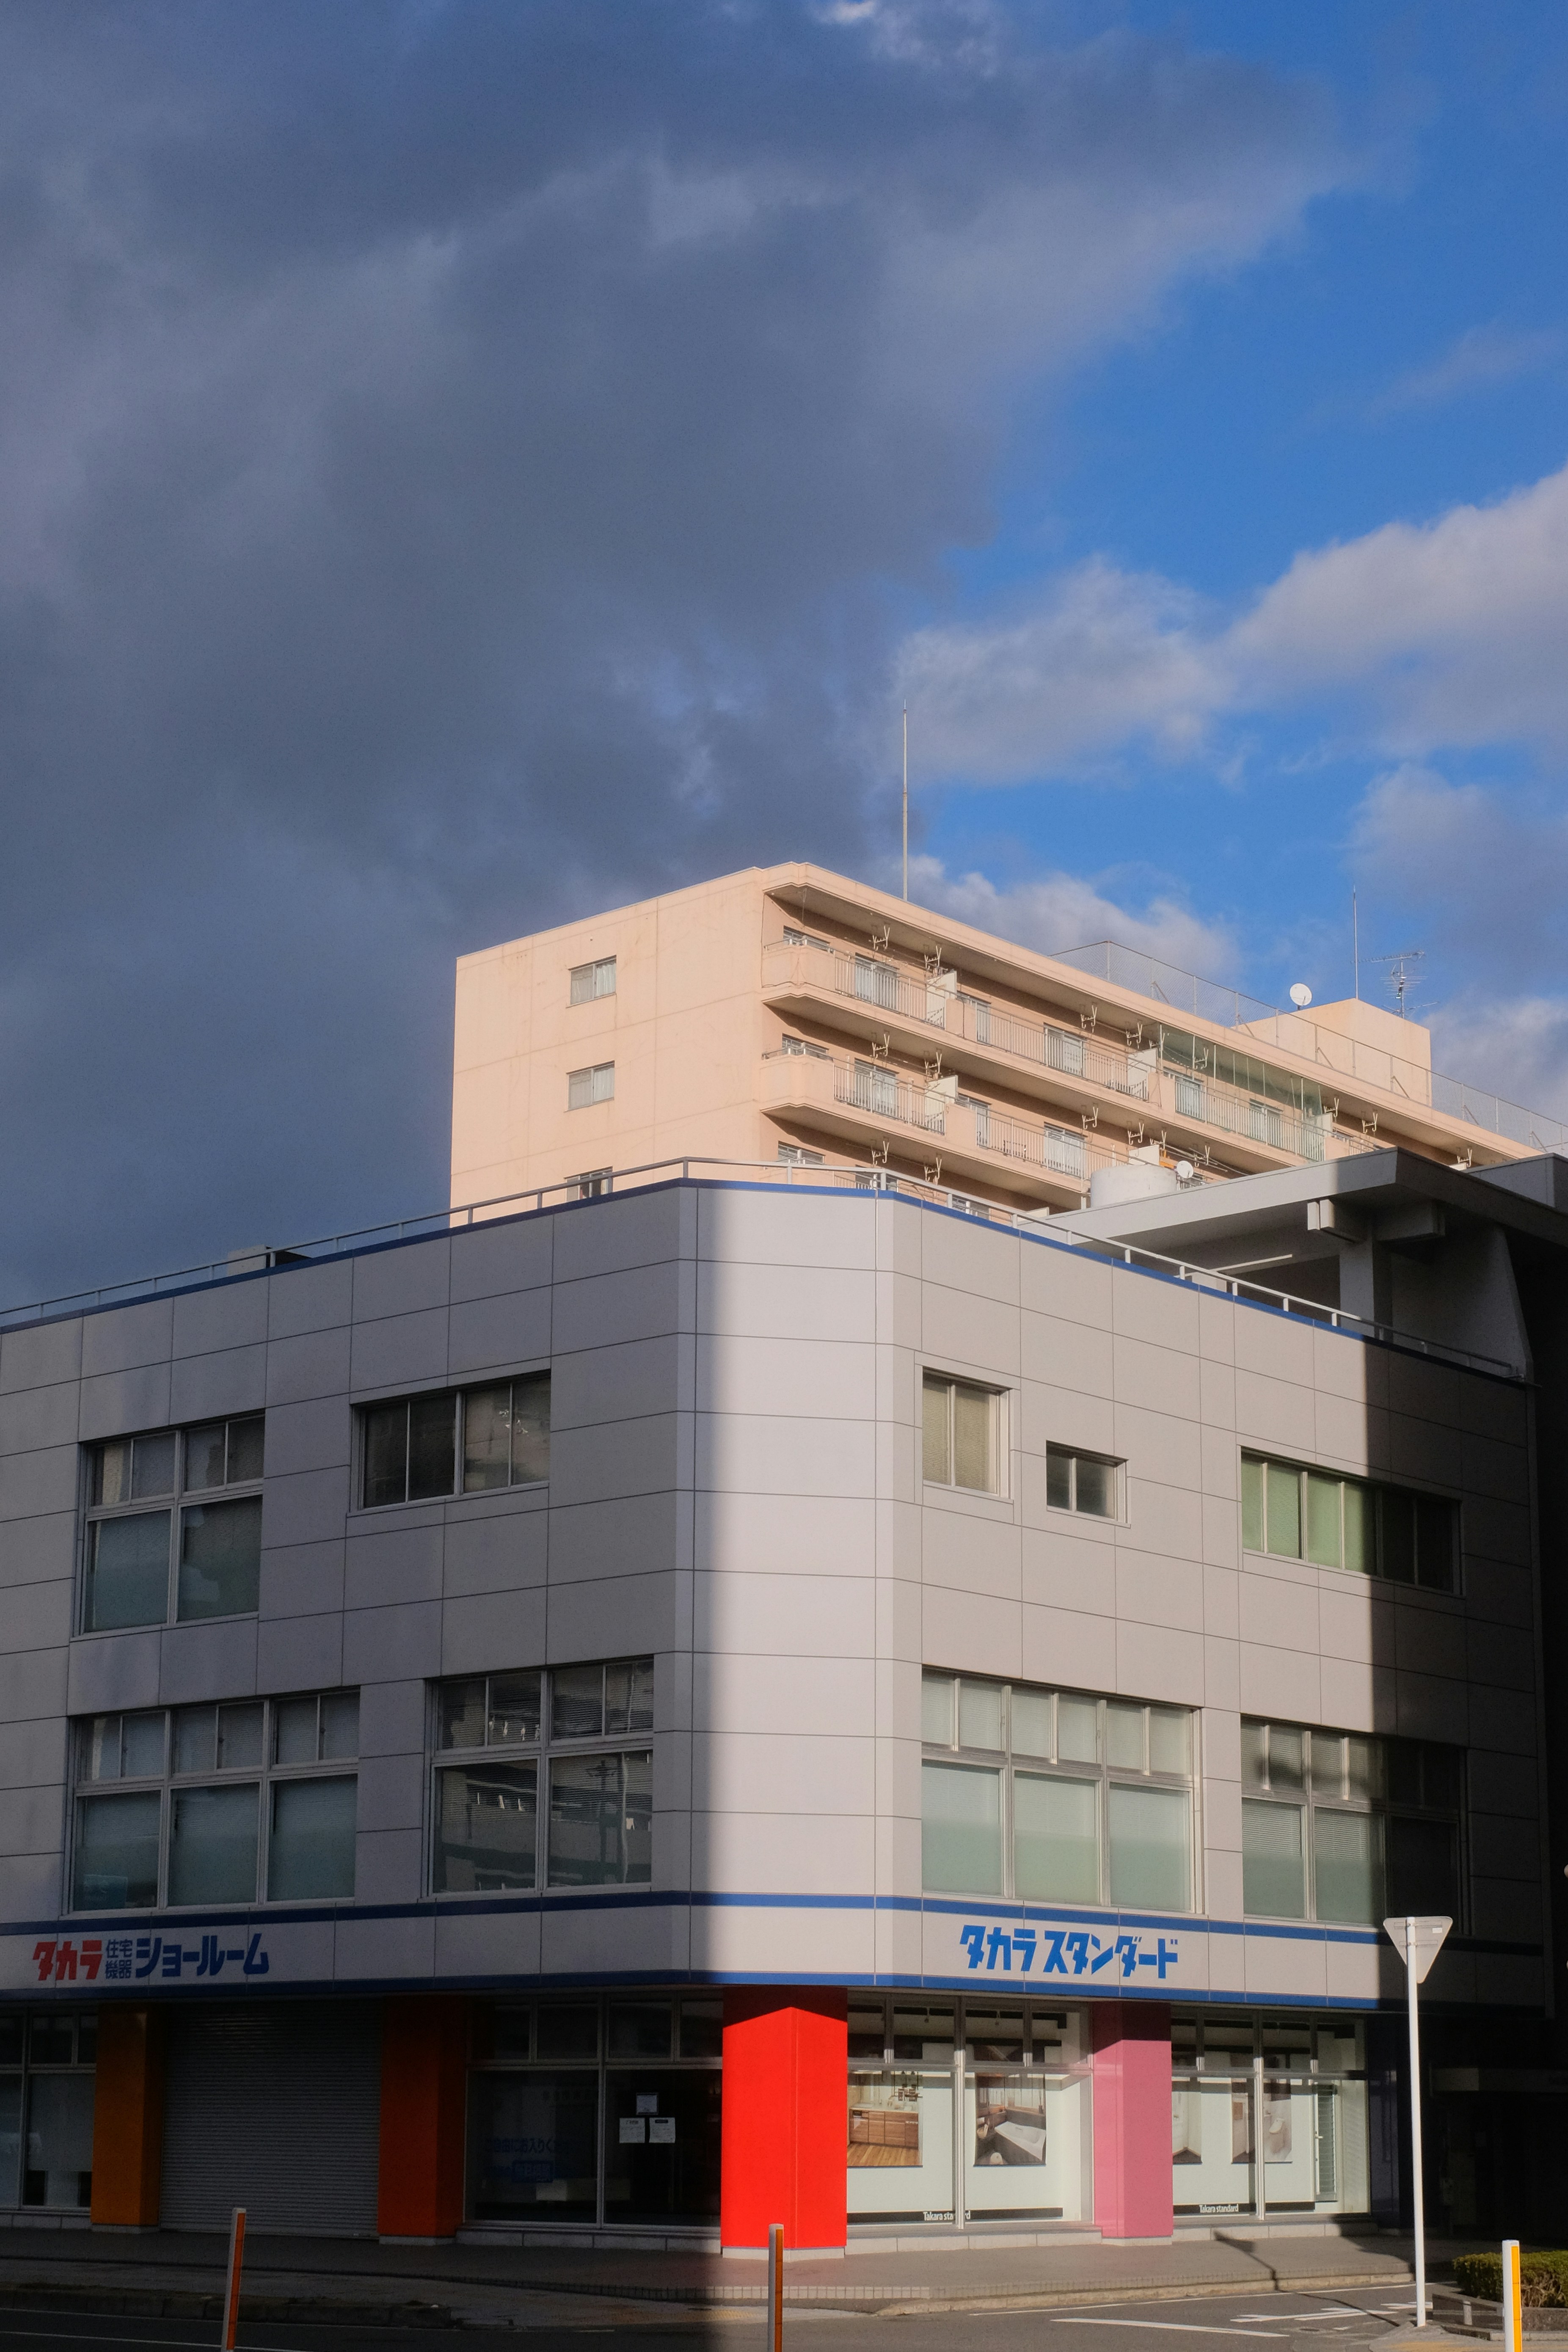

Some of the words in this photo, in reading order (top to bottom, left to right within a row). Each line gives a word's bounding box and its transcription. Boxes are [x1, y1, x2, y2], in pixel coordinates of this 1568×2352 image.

[33, 1940, 103, 1981] タカラ
[106, 1939, 133, 1958] 住宅
[135, 1933, 270, 1978] ショールーム
[959, 1925, 1178, 1979] タカラスタンダード
[923, 2212, 943, 2221] Takara
[943, 2210, 970, 2220] stad
[1199, 2204, 1216, 2213] Takara
[1216, 2203, 1239, 2213] standard
